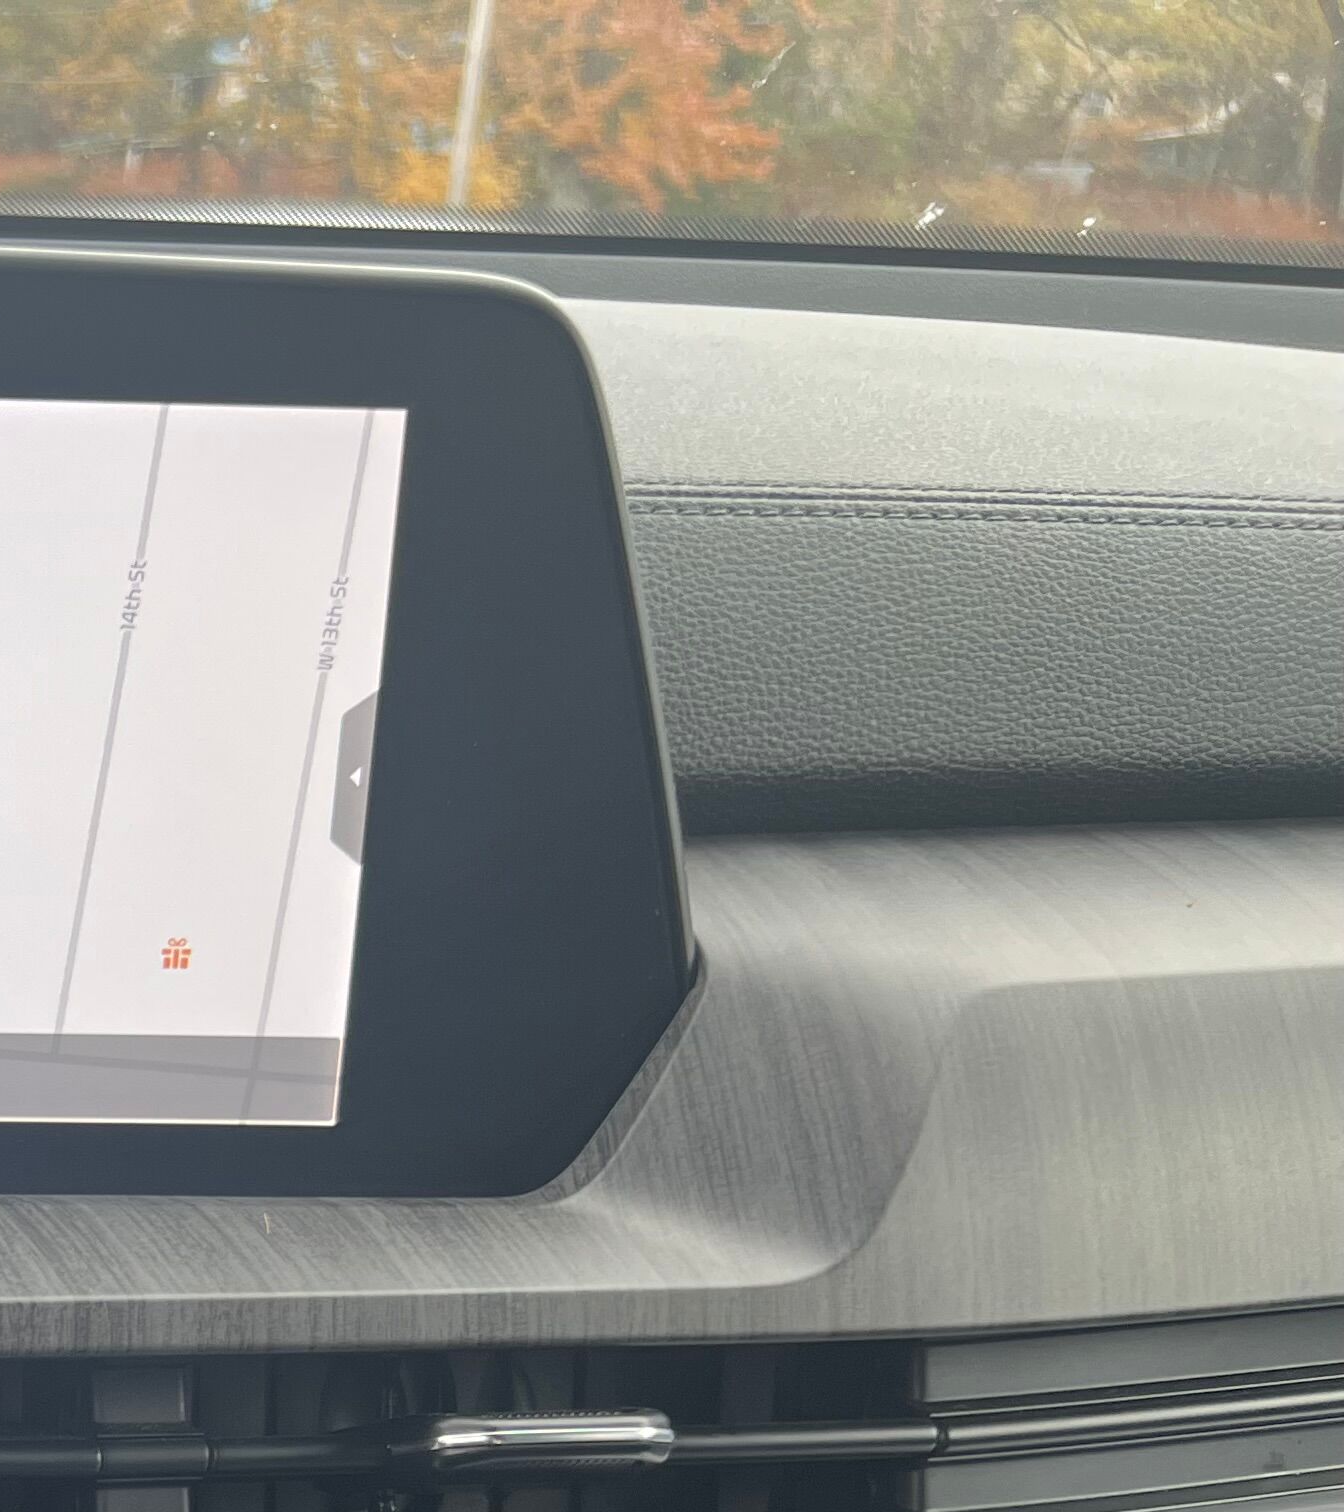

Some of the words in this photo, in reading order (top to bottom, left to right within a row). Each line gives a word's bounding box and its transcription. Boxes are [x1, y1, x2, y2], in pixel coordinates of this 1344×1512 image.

[128, 560, 148, 582] St
[330, 577, 349, 600] St
[120, 589, 142, 632] 14th
[321, 604, 343, 648] 13th
